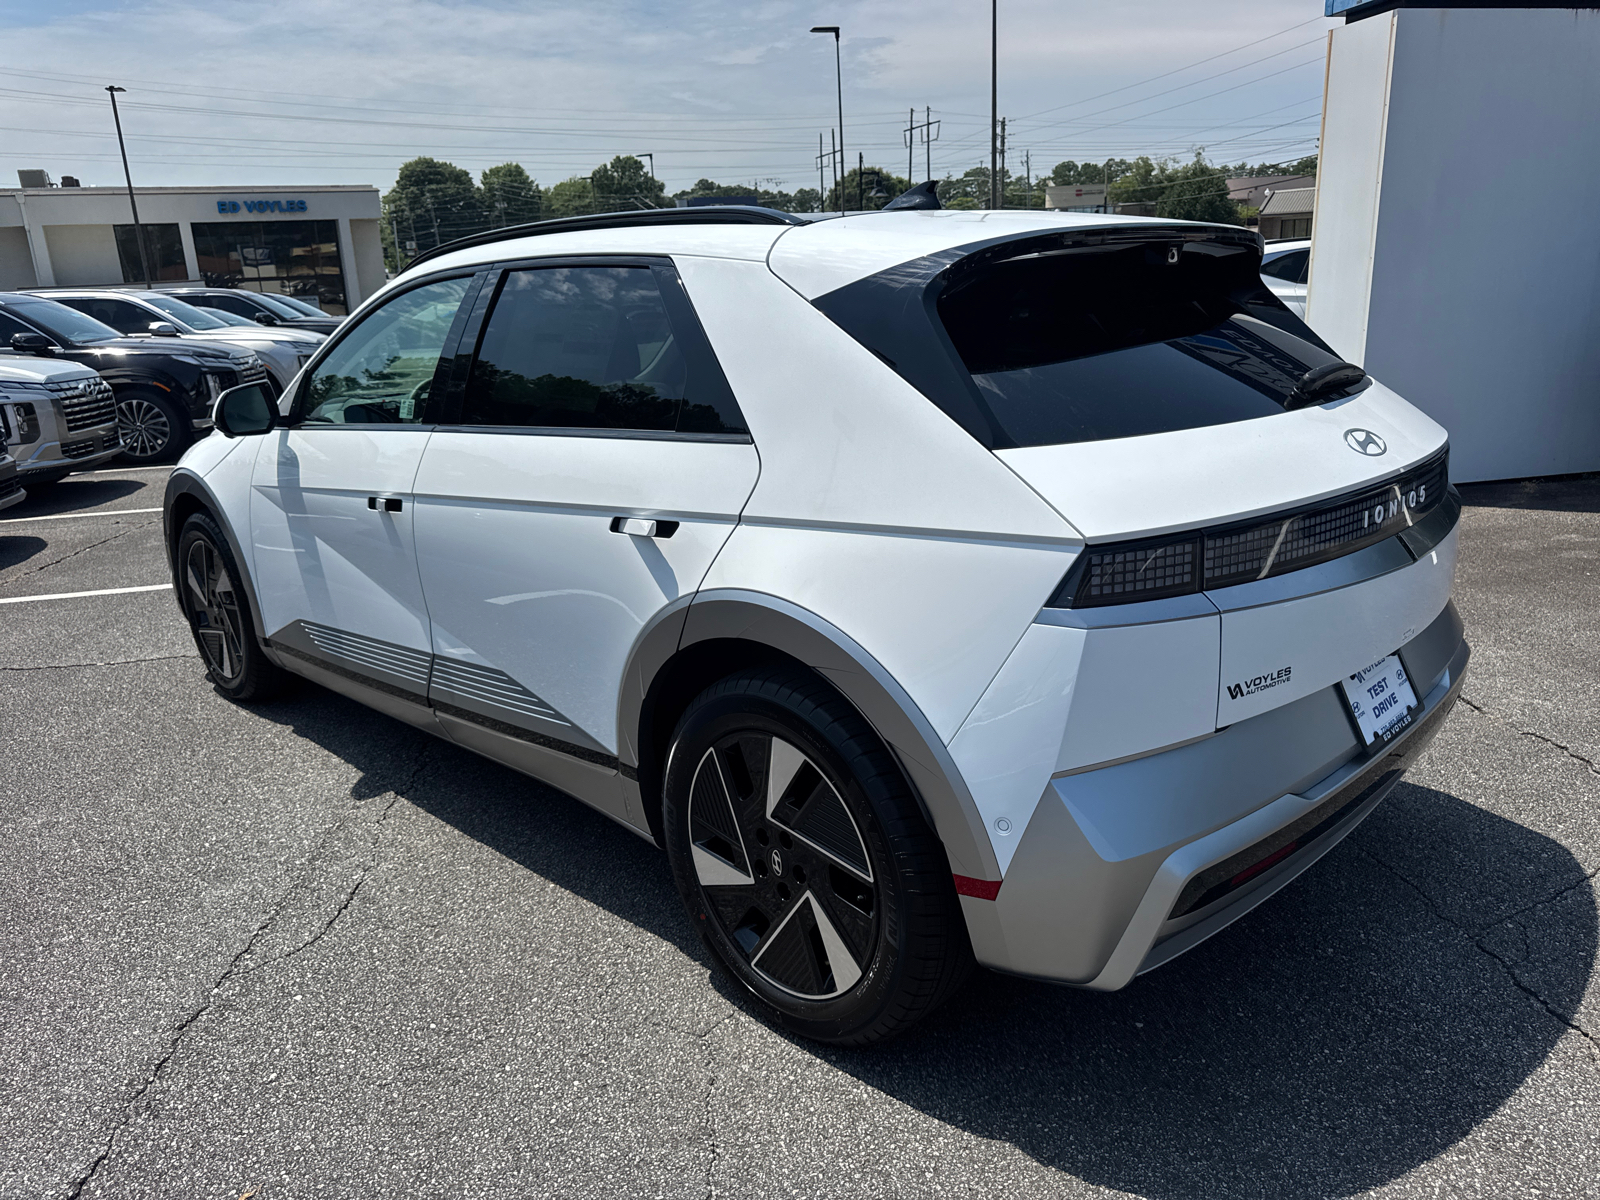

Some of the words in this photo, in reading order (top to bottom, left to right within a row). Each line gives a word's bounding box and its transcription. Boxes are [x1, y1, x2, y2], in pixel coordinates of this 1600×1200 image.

[217, 201, 240, 213] ED
[243, 200, 308, 213] VOYLES
[1244, 666, 1292, 689] VOYLES
[1245, 675, 1291, 696] AUTOMOTIVE
[1366, 676, 1389, 700] TEST
[1372, 691, 1399, 719] DRIVE
[1382, 731, 1392, 741] ED
[1390, 715, 1412, 735] VOYLES
